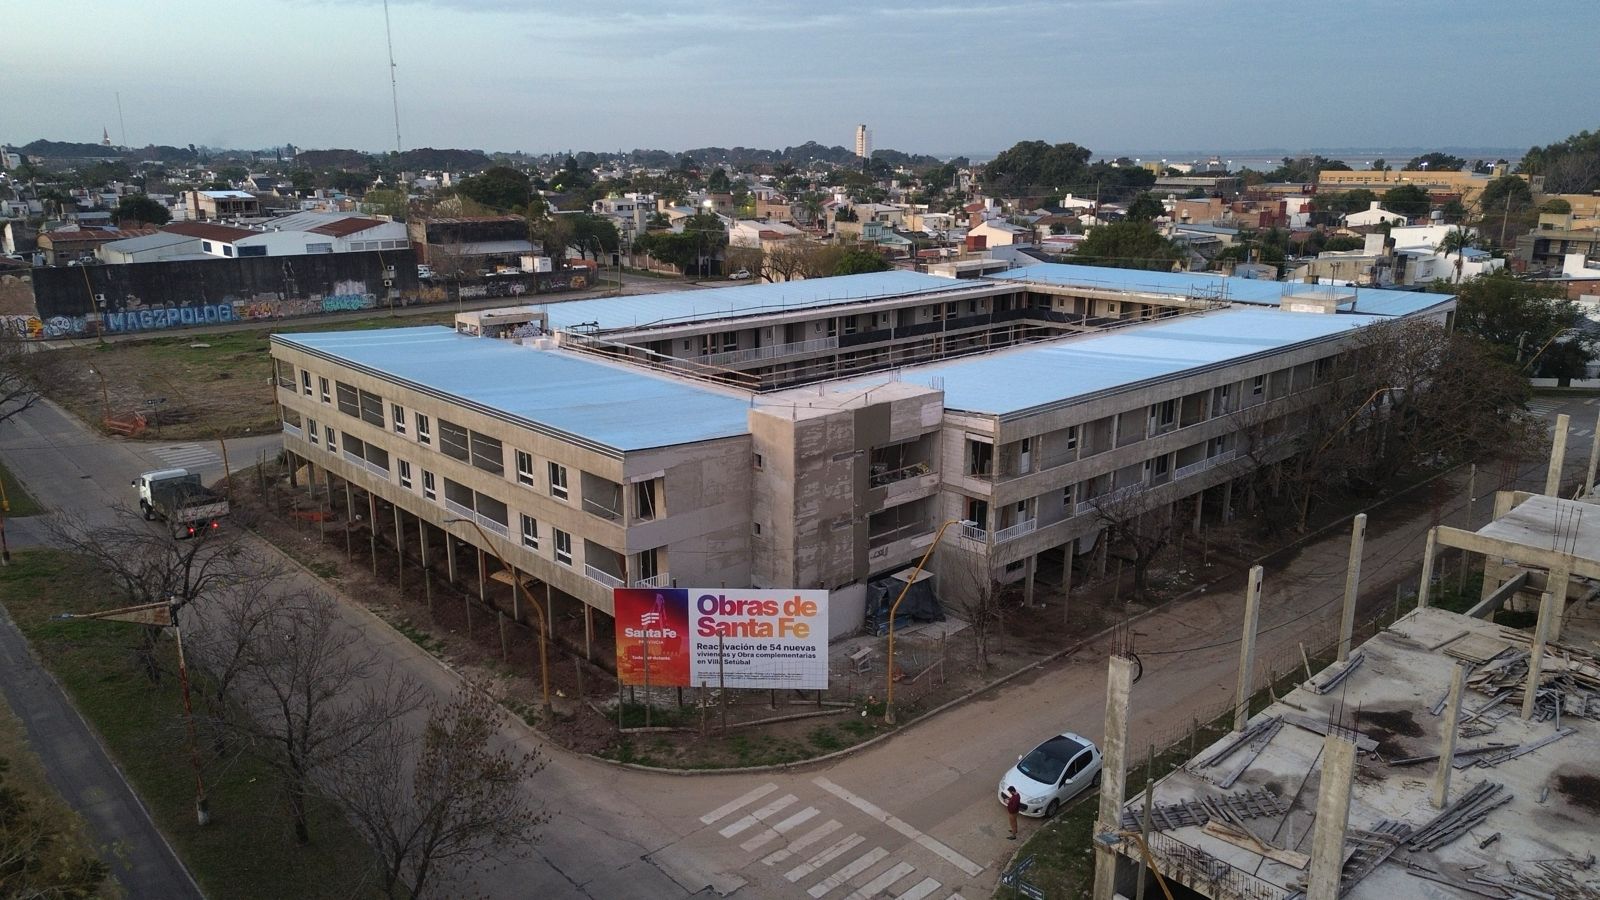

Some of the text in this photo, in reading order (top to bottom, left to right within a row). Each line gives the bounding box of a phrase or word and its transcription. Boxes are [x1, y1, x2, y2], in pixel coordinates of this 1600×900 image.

[697, 595, 817, 617] Obras de
[625, 628, 677, 638] Santa Fe
[697, 617, 810, 638] Santa Fe
[696, 643, 755, 651] Reacivación
